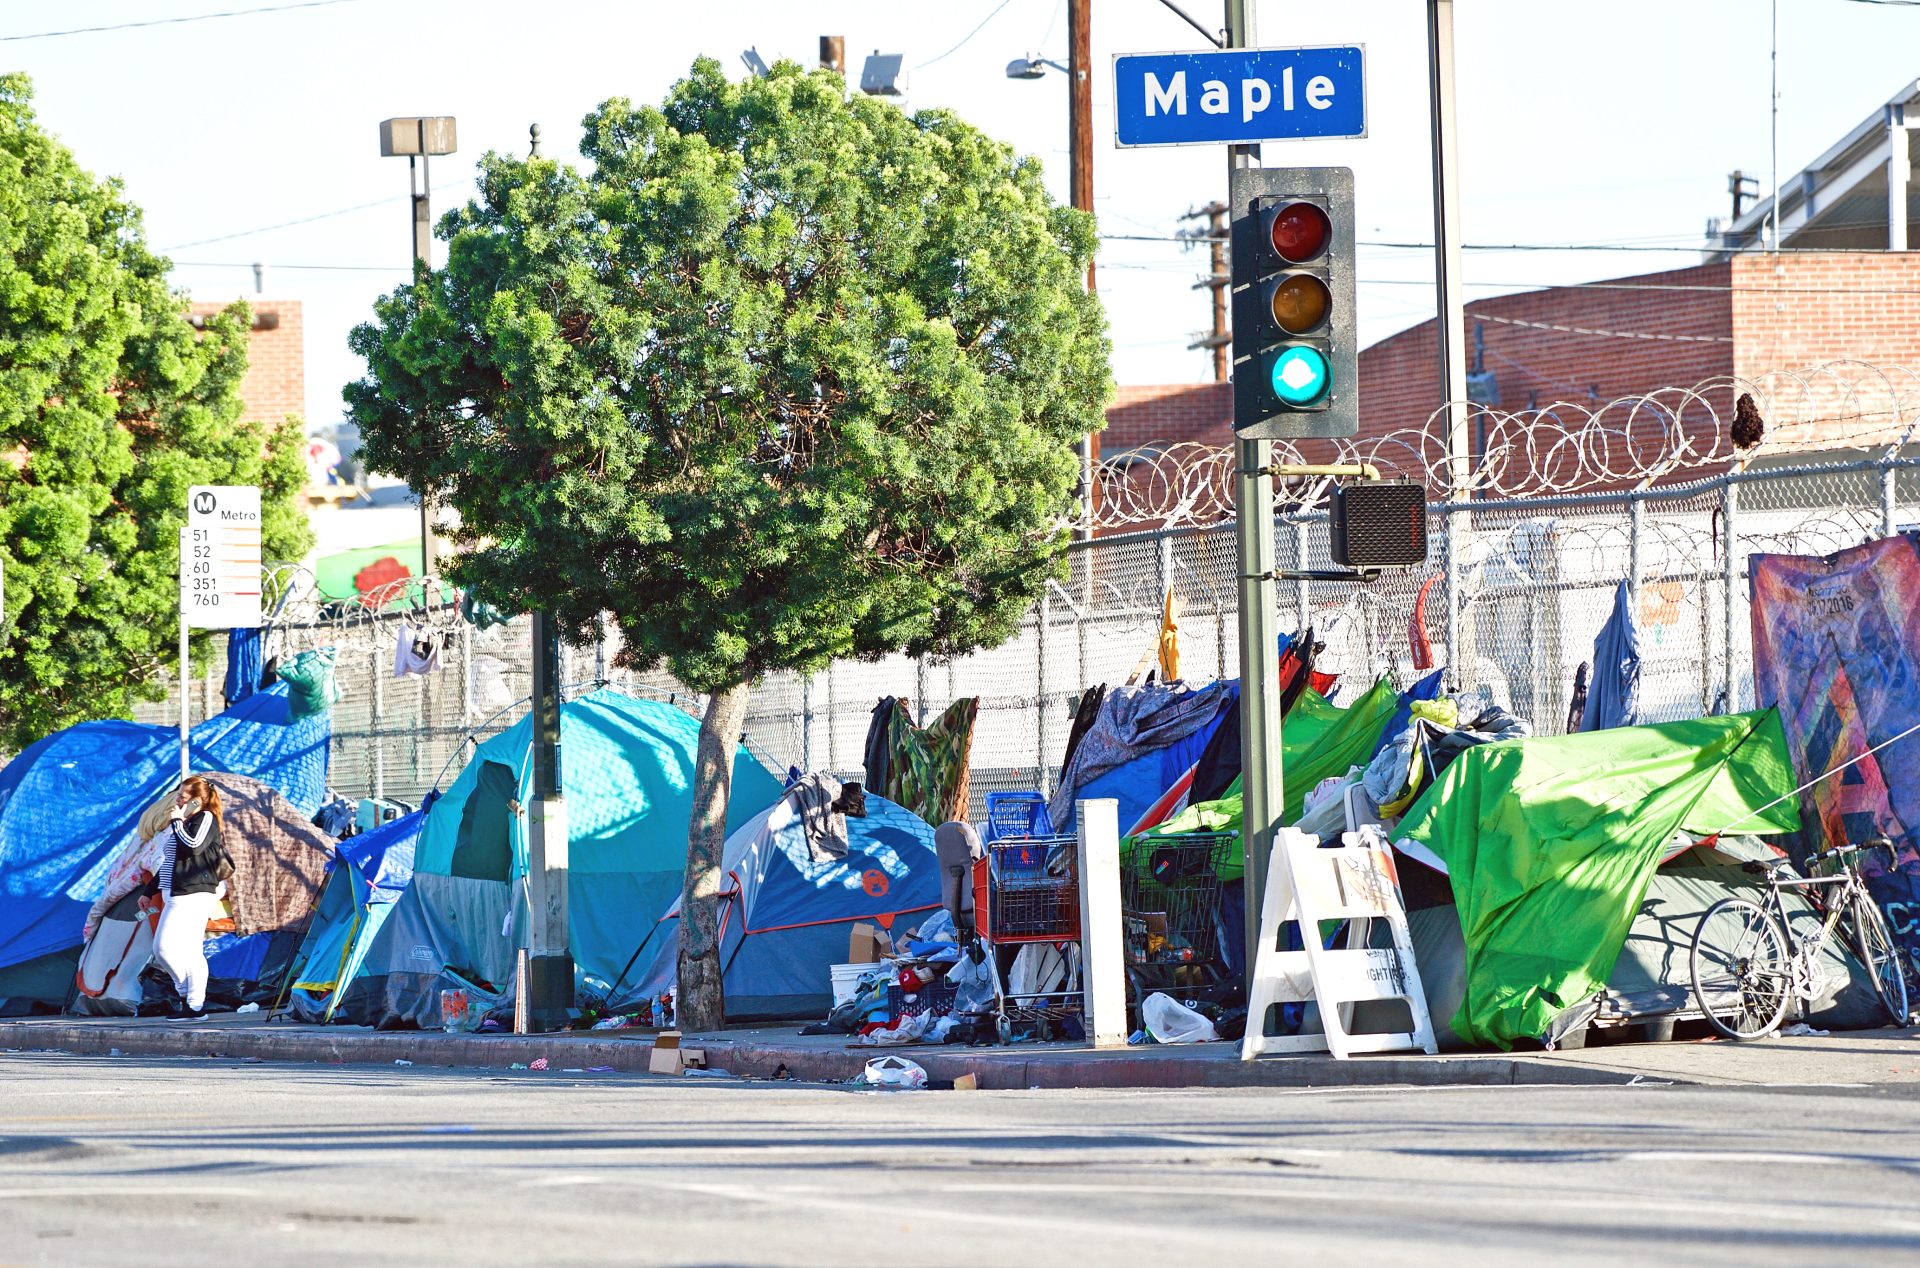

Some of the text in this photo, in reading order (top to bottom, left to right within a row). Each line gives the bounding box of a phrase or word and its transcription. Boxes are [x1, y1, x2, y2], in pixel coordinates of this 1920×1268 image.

[1144, 66, 1336, 124] Maple
[221, 510, 257, 521] Metro
[193, 529, 209, 542] 51
[193, 545, 211, 558] 52
[193, 562, 210, 574] 60
[193, 578, 217, 590] 351
[193, 594, 220, 606] 760
